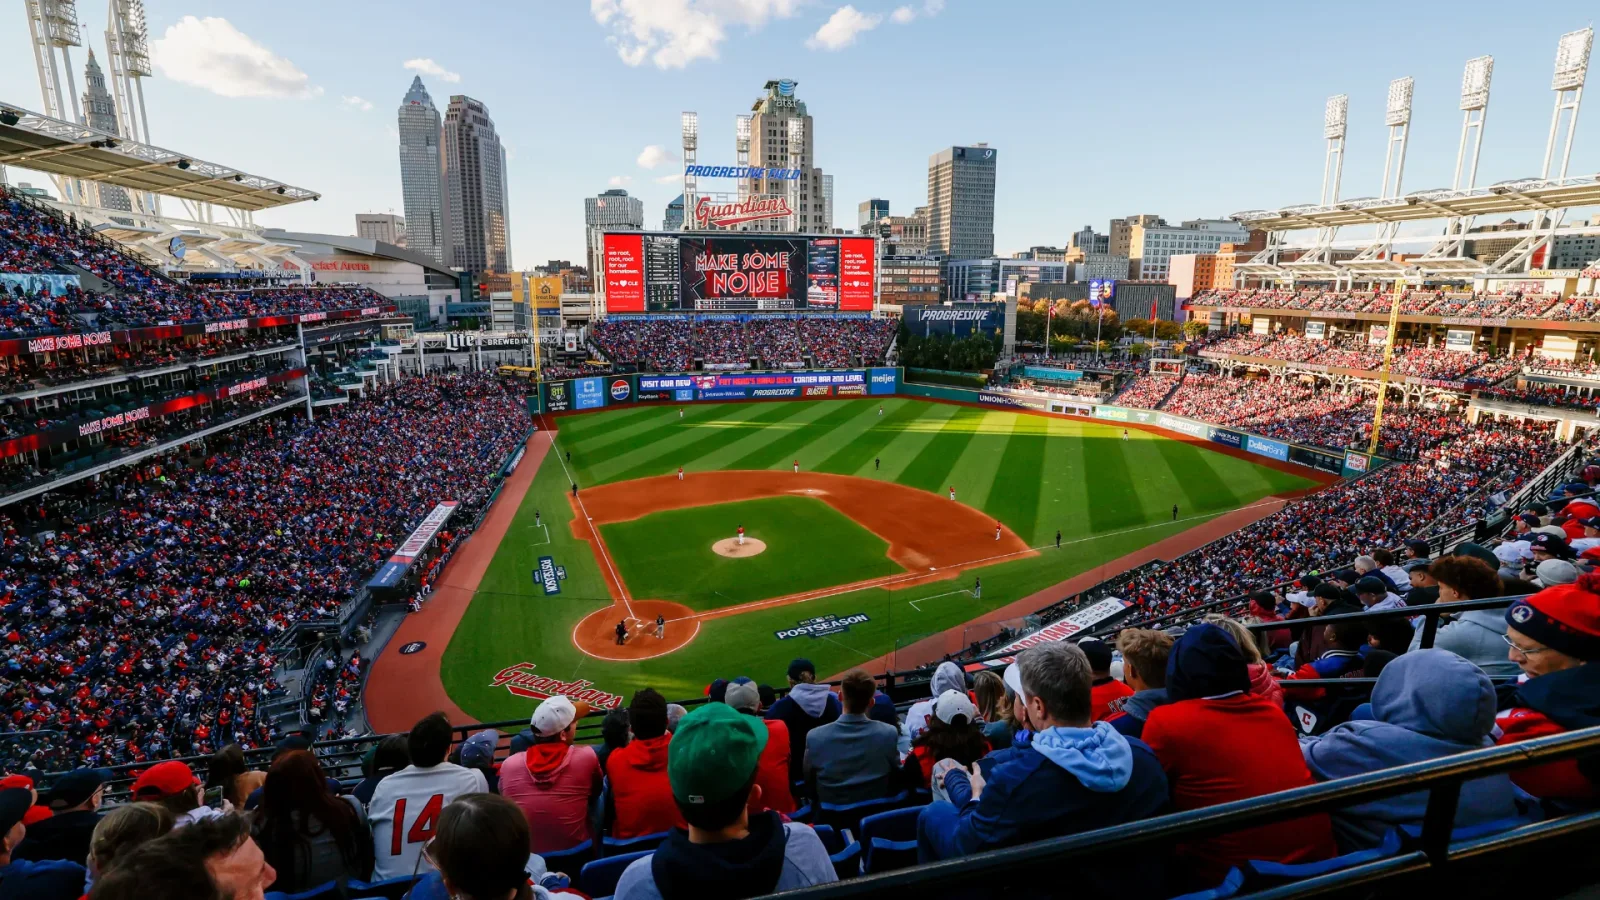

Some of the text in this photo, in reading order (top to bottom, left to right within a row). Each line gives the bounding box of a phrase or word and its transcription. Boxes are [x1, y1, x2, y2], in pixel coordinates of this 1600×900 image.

[776, 99, 797, 108] at&t
[684, 165, 801, 180] PROGRESSIVE FIELD
[695, 195, 793, 227] Guardians
[312, 260, 372, 271] cket Arena
[695, 253, 738, 271] MAKE
[742, 252, 789, 269] SOME
[713, 271, 779, 294] NOISE
[921, 310, 989, 321] PROGRESSIVE
[28, 331, 112, 353] MAKE SOME NOISE
[446, 333, 474, 351] Lite
[487, 338, 520, 346] BREWED
[641, 379, 690, 388] VISIT OUR NEW
[872, 374, 895, 384] meijer
[551, 386, 564, 396] 811
[753, 388, 797, 396] PROGRESSIVE
[79, 406, 150, 436] MAKE SOME NOISE
[1160, 417, 1203, 434] PROGRESSIVE
[1347, 453, 1364, 465] drug
[1348, 460, 1366, 470] mart
[541, 559, 558, 593] POSTSEASON
[776, 614, 868, 640] POSTSEASON
[488, 661, 624, 711] Guardians
[390, 793, 444, 857] 14
